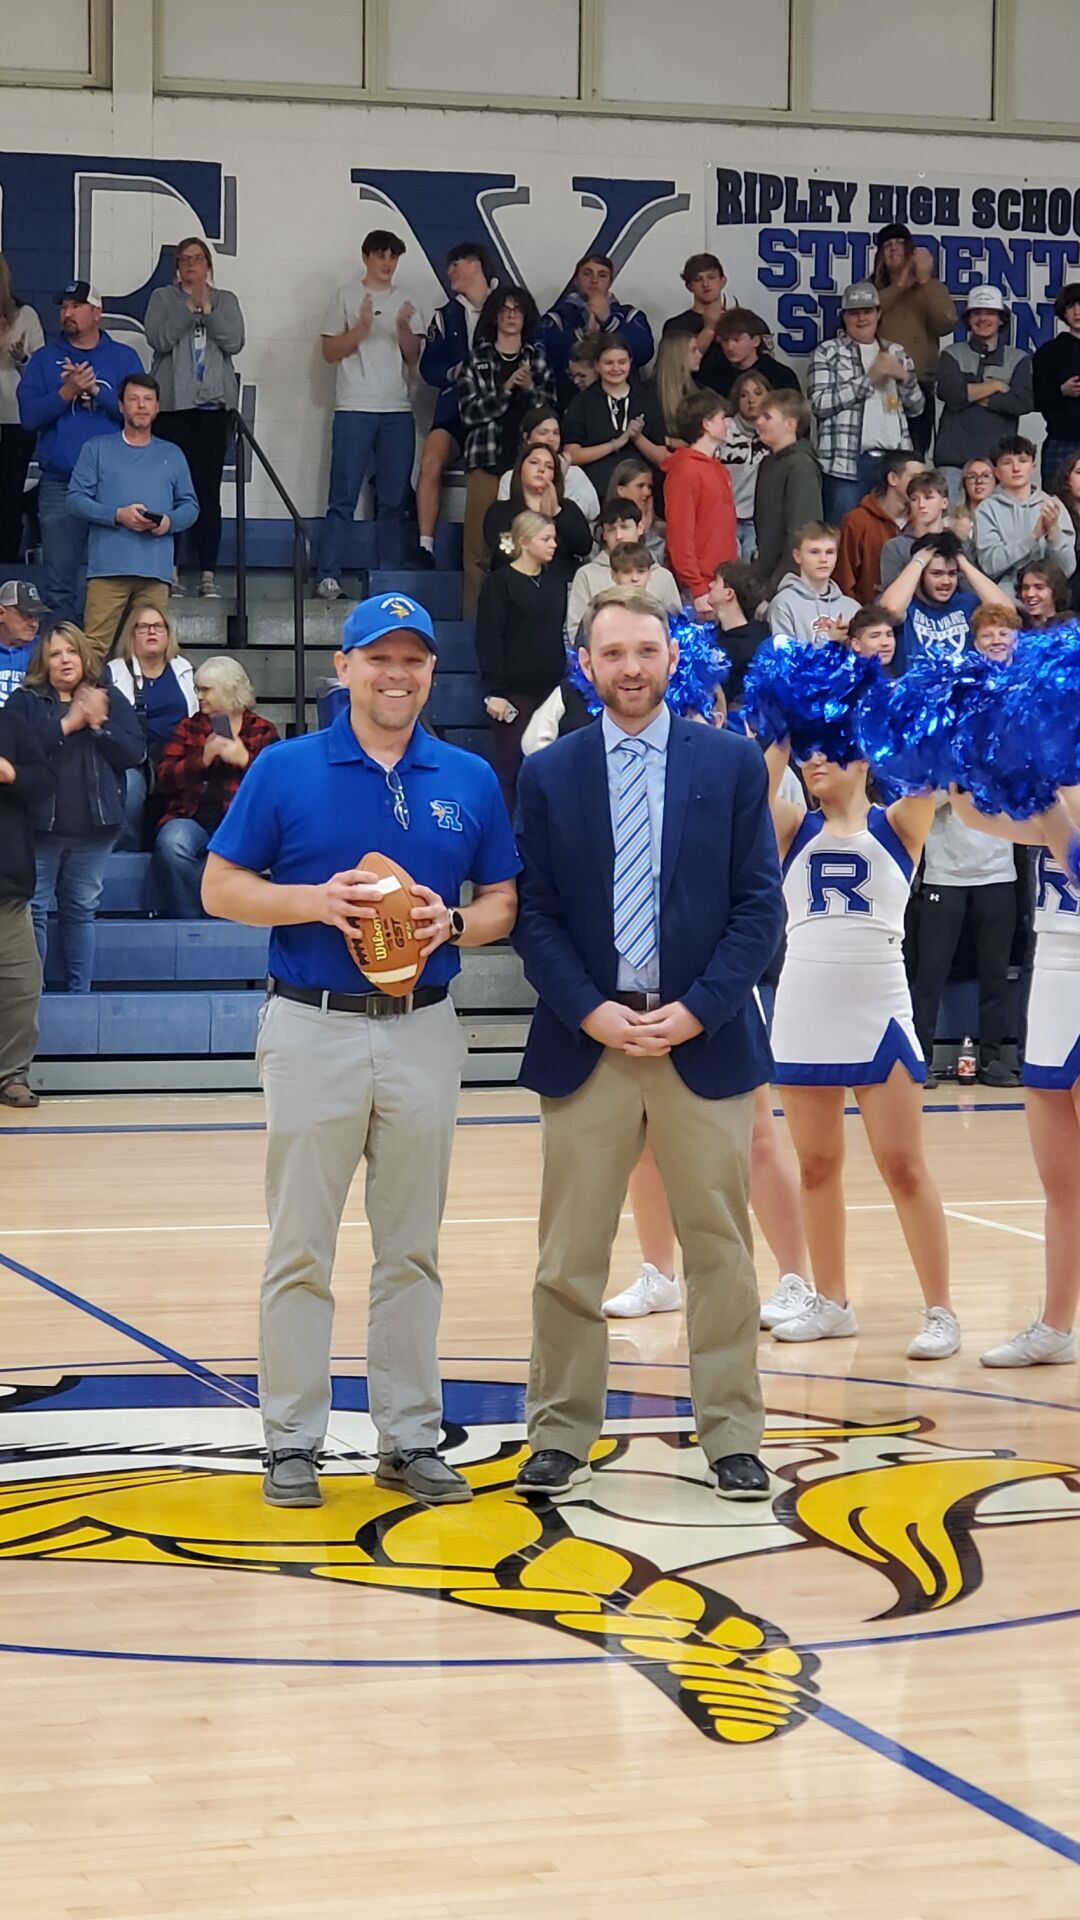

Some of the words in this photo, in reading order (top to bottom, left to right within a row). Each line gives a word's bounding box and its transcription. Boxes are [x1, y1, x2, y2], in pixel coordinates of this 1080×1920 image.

[716, 167, 858, 226] RIPLEY
[868, 183, 960, 227] HIGH
[806, 850, 874, 917] R
[372, 916, 388, 961] Wilson
[390, 916, 406, 948] GST
